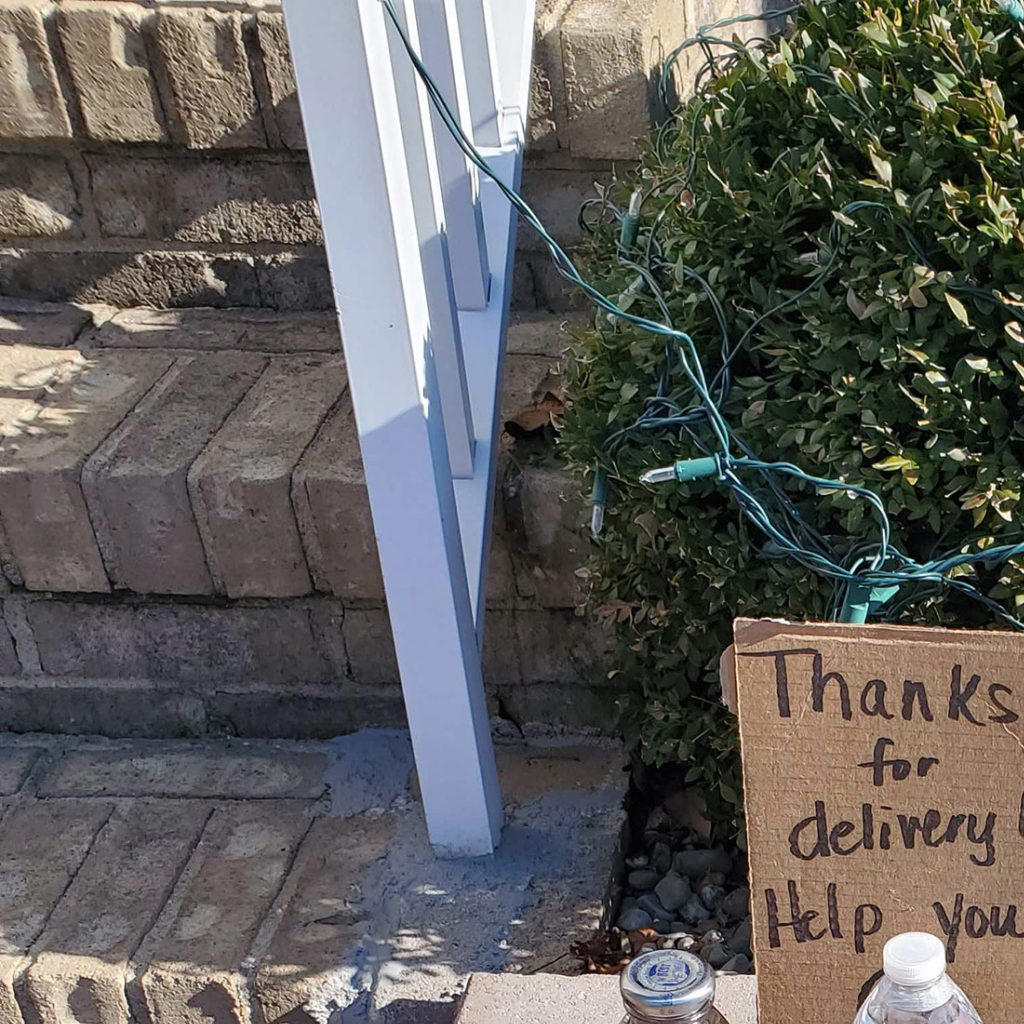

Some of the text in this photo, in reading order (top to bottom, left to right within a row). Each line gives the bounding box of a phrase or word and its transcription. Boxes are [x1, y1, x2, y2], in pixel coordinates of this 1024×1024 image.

[737, 648, 1019, 726] Thanks
[857, 737, 939, 786] for
[764, 879, 883, 954] Help
